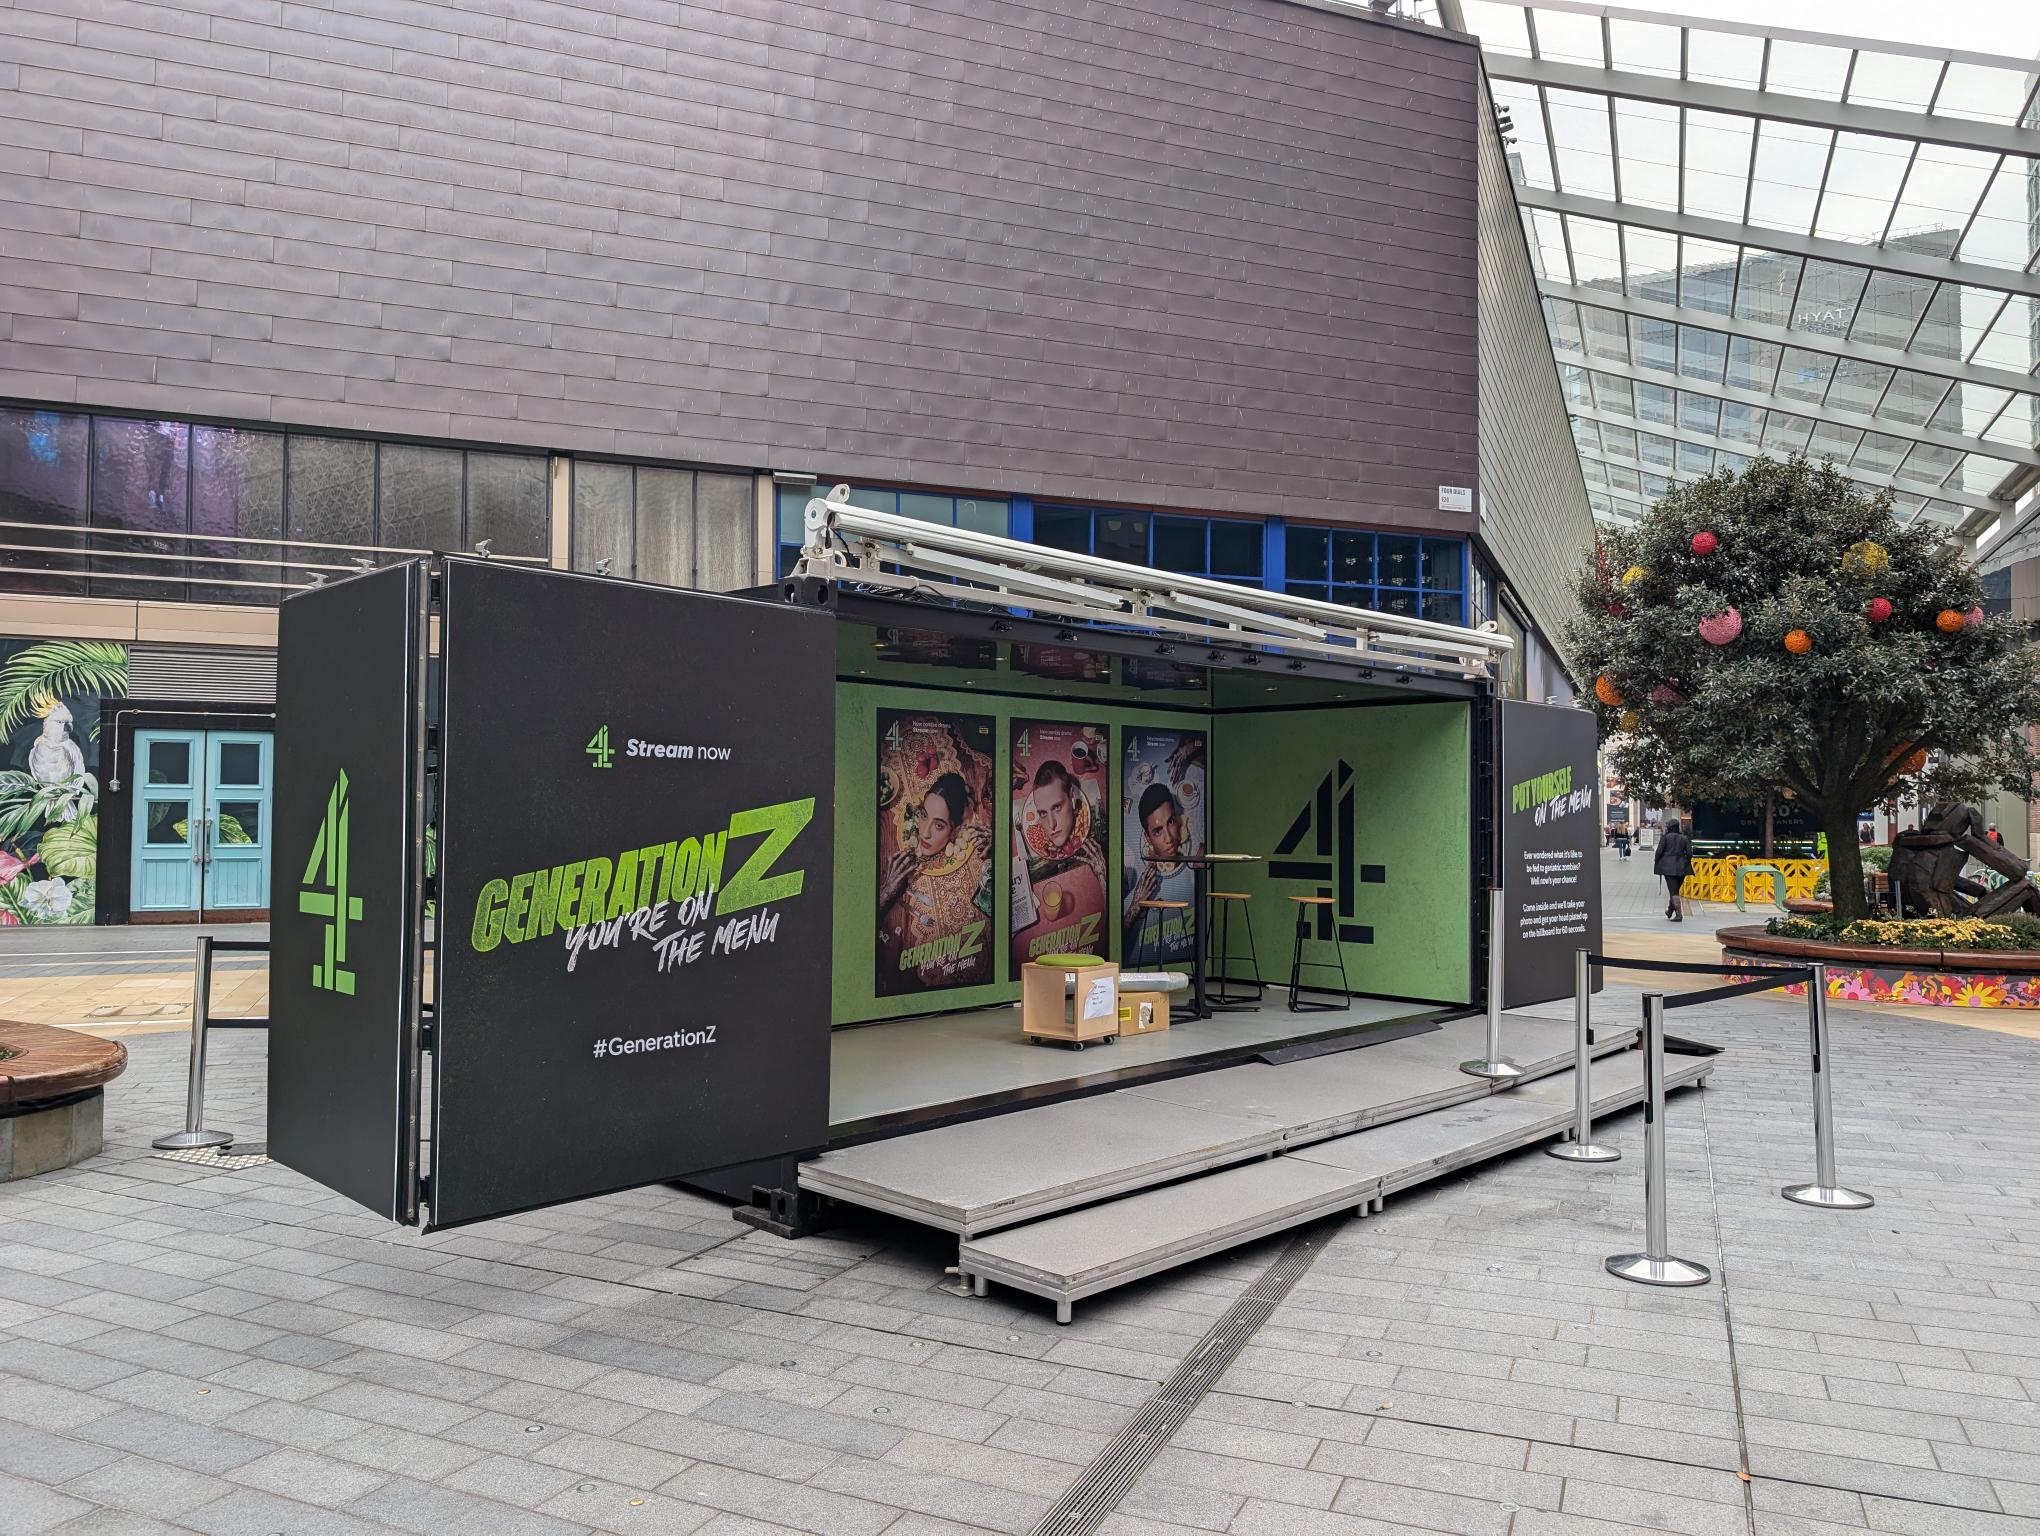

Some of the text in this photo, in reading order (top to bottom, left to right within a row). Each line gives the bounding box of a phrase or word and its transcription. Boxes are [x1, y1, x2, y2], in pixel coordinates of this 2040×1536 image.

[585, 724, 732, 768] 4 Stream now
[884, 719, 903, 751] 4
[1016, 728, 1031, 757] 4
[1512, 765, 1572, 814] PUT YOURSELF
[1534, 784, 1592, 828] ON THE MENU
[470, 796, 816, 953] GENERATION Z
[1553, 849, 1564, 859] what
[299, 767, 363, 995] 4
[565, 882, 716, 972] YOU'RE ON
[1520, 916, 1533, 928] photo
[1533, 915, 1541, 925] and
[1541, 915, 1549, 926] get
[1548, 915, 1559, 925] your
[1558, 913, 1569, 922] head
[1568, 911, 1582, 922] plated
[1522, 903, 1536, 912] Come
[1535, 901, 1549, 911] inside
[1549, 900, 1558, 910] and
[1566, 899, 1576, 909] take
[1575, 901, 1585, 910] your
[652, 907, 780, 973] THE MENU
[899, 919, 986, 971] GENERATION Z
[1028, 911, 1101, 957] GENERATION Z
[1522, 931, 1529, 939] on
[1528, 929, 1536, 938] the
[1535, 926, 1556, 937] billboard
[1561, 925, 1568, 934] 60
[942, 955, 976, 976] THE MENU
[592, 1025, 717, 1059] #GenerationZ
